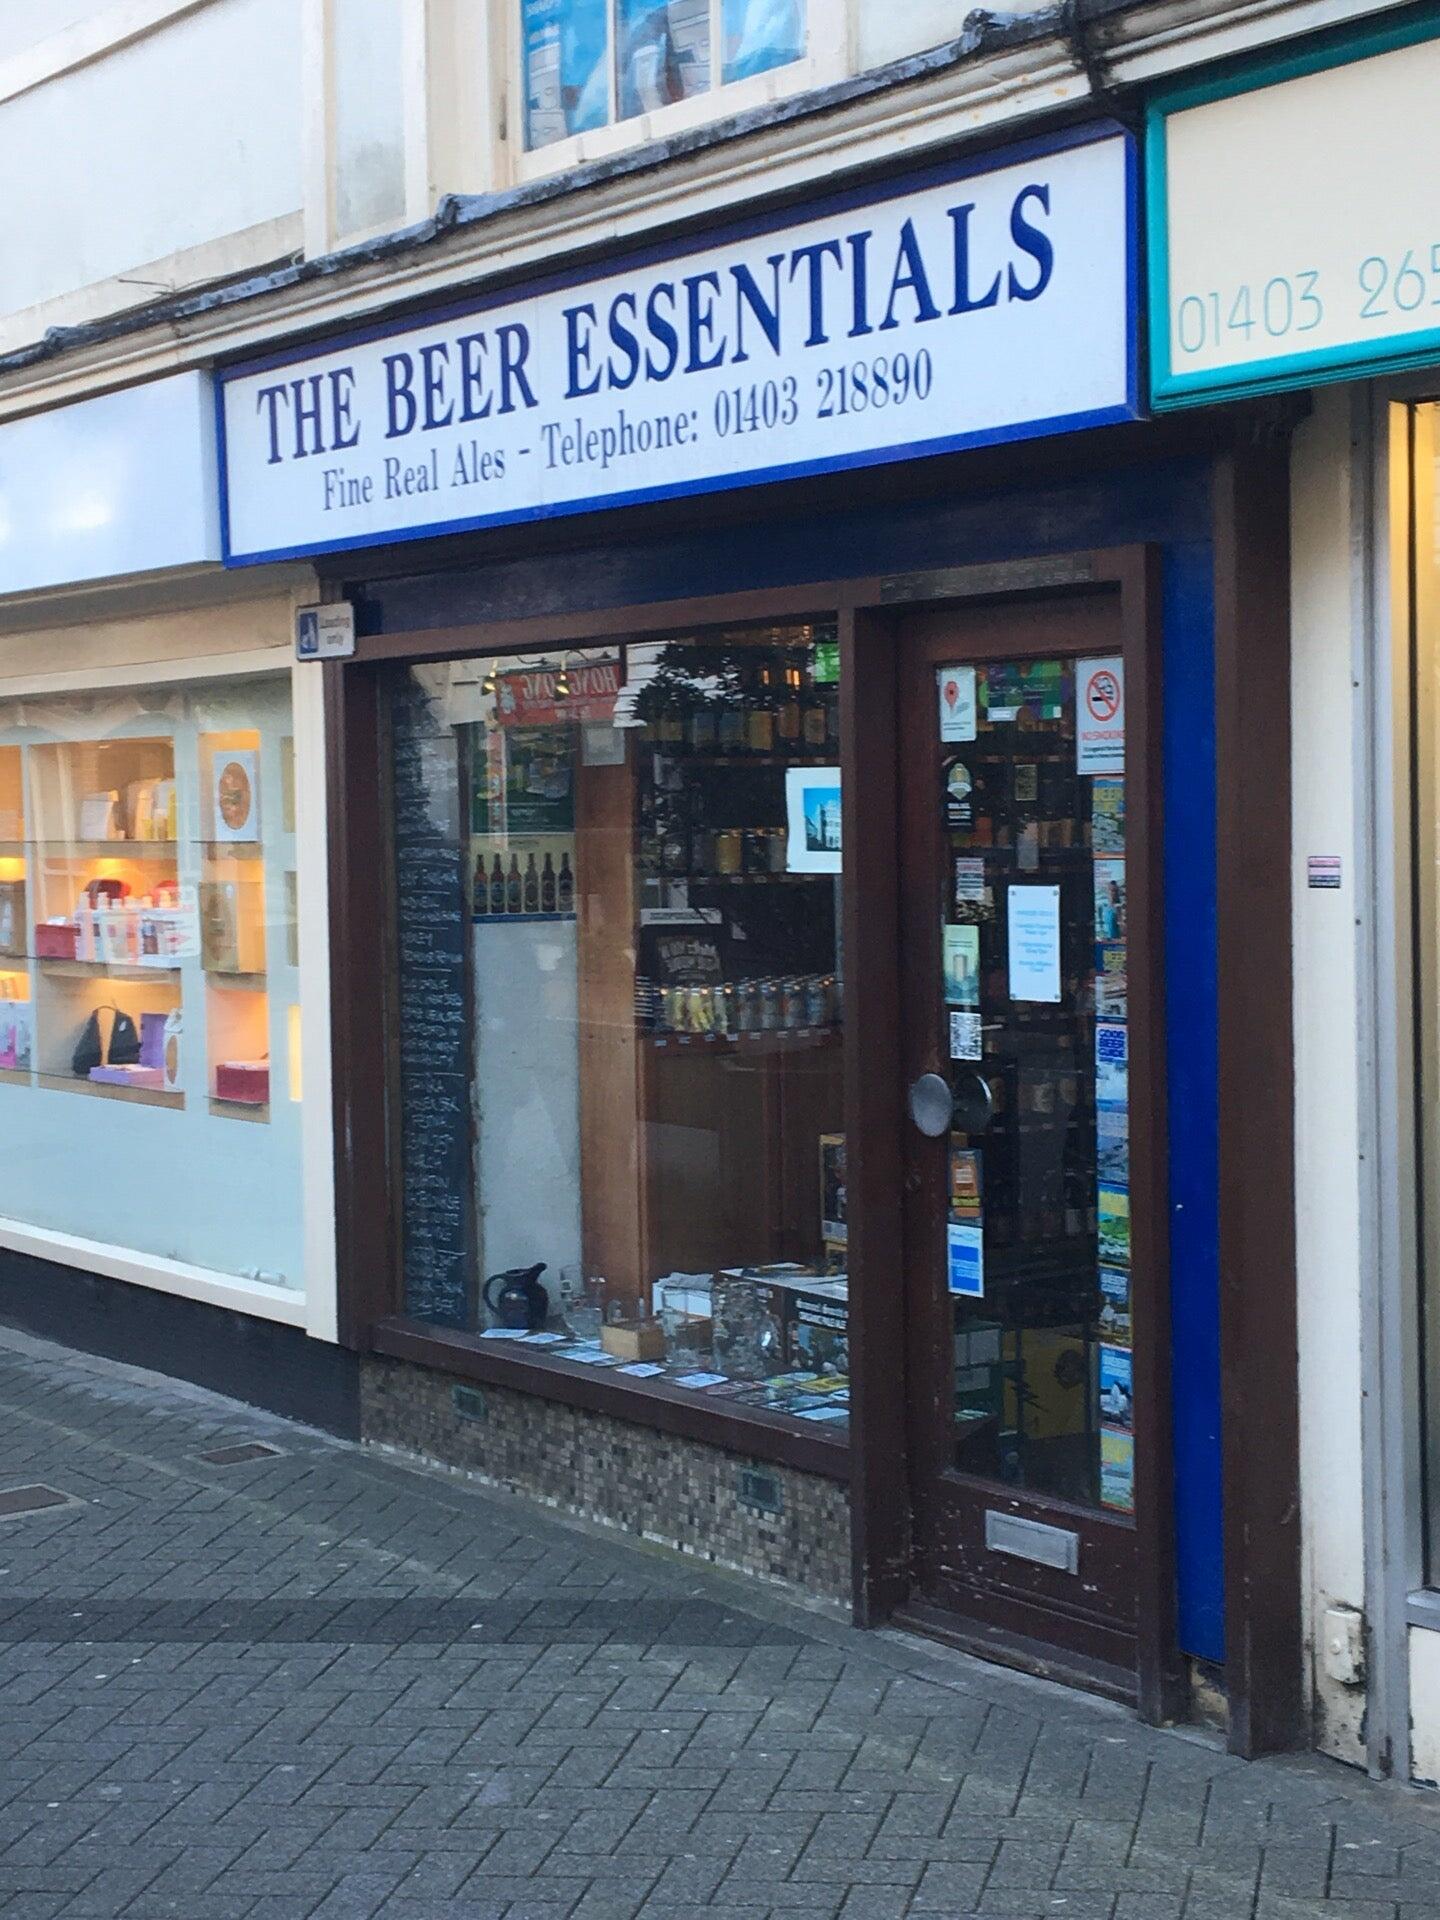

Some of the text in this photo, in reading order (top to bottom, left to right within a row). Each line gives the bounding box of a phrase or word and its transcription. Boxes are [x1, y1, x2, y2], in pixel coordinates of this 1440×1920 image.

[257, 183, 1054, 465] THE BEER ESSENTIALS
[1178, 270, 1323, 353] 01403
[322, 468, 373, 511] Fine
[384, 449, 439, 500] Real
[450, 439, 505, 487] Ales
[541, 408, 698, 470] Telephone:
[714, 376, 799, 437] 01403
[817, 348, 933, 418] 218890
